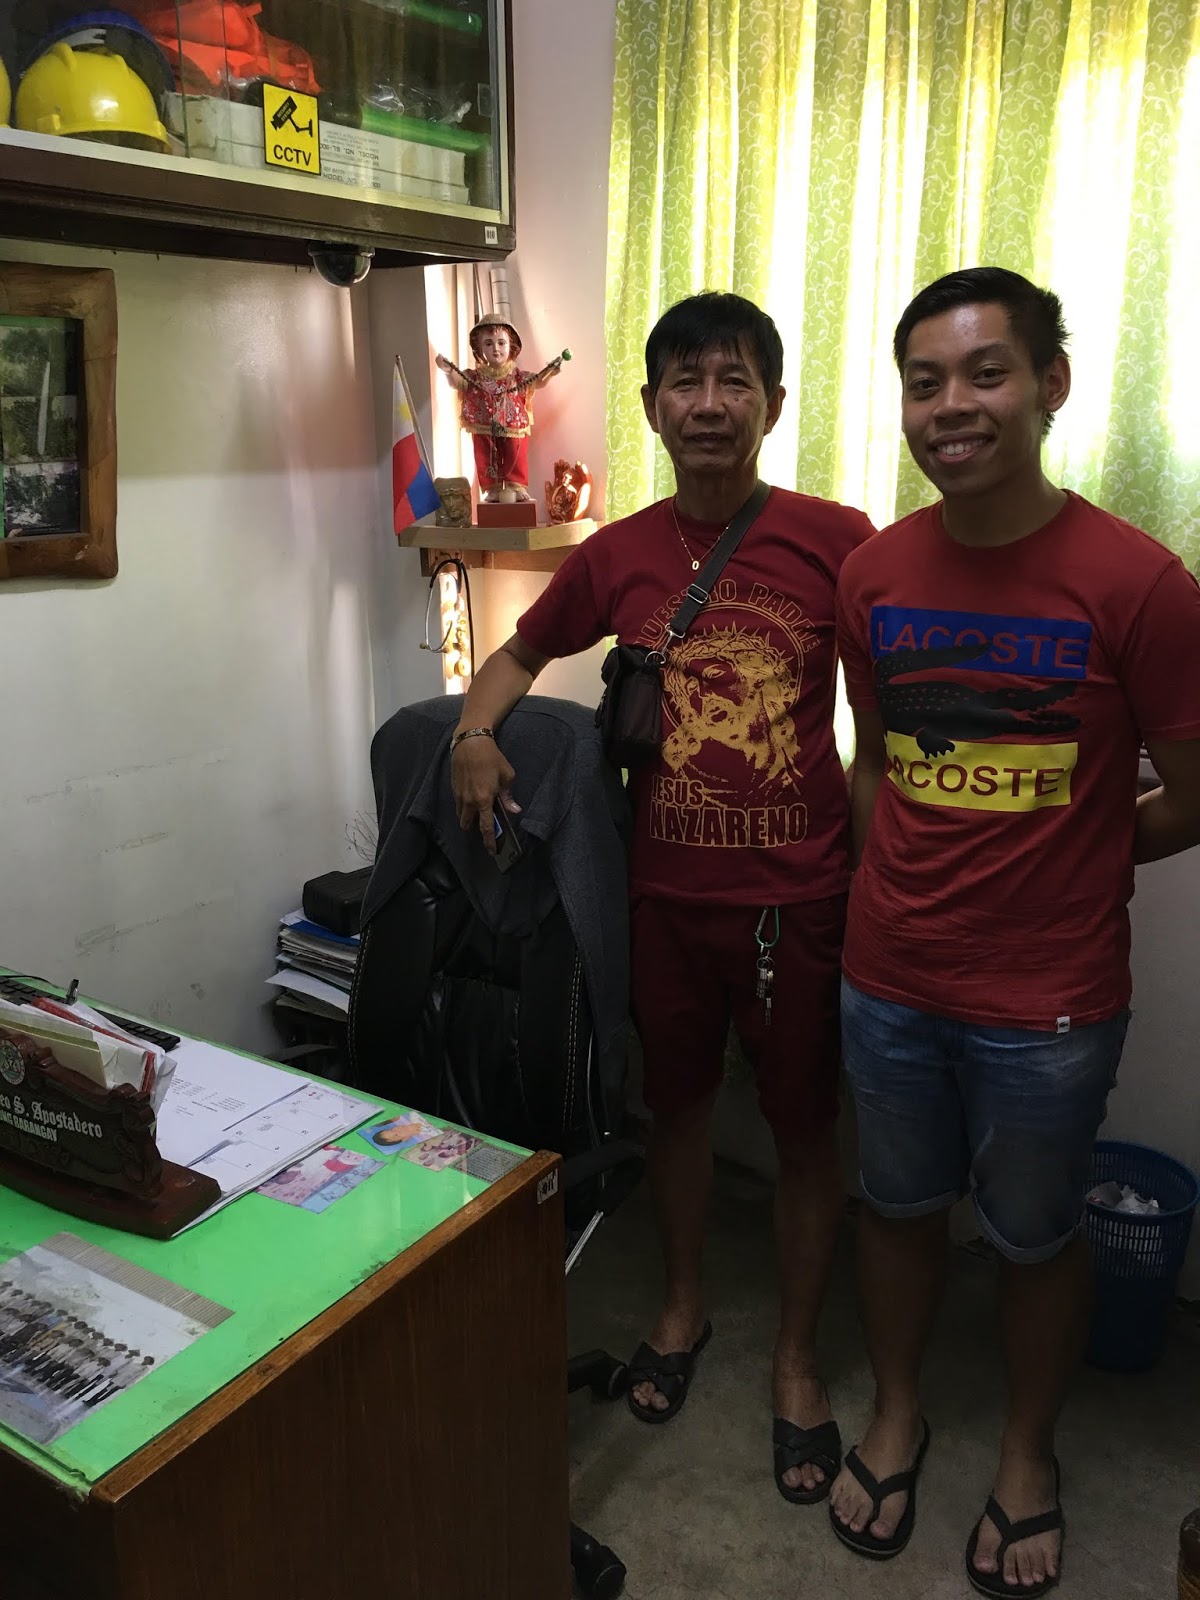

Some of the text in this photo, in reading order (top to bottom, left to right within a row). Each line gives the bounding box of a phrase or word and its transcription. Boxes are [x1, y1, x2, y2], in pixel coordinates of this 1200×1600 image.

[273, 144, 312, 167] CCTV
[633, 578, 822, 653] NUESRO PADRE
[650, 774, 705, 808] JESUS
[890, 754, 1065, 797] ACOSTE
[649, 800, 808, 848] NAZARENO
[13, 1115, 57, 1142] BARANGAY
[31, 1101, 103, 1138] Apostadero
